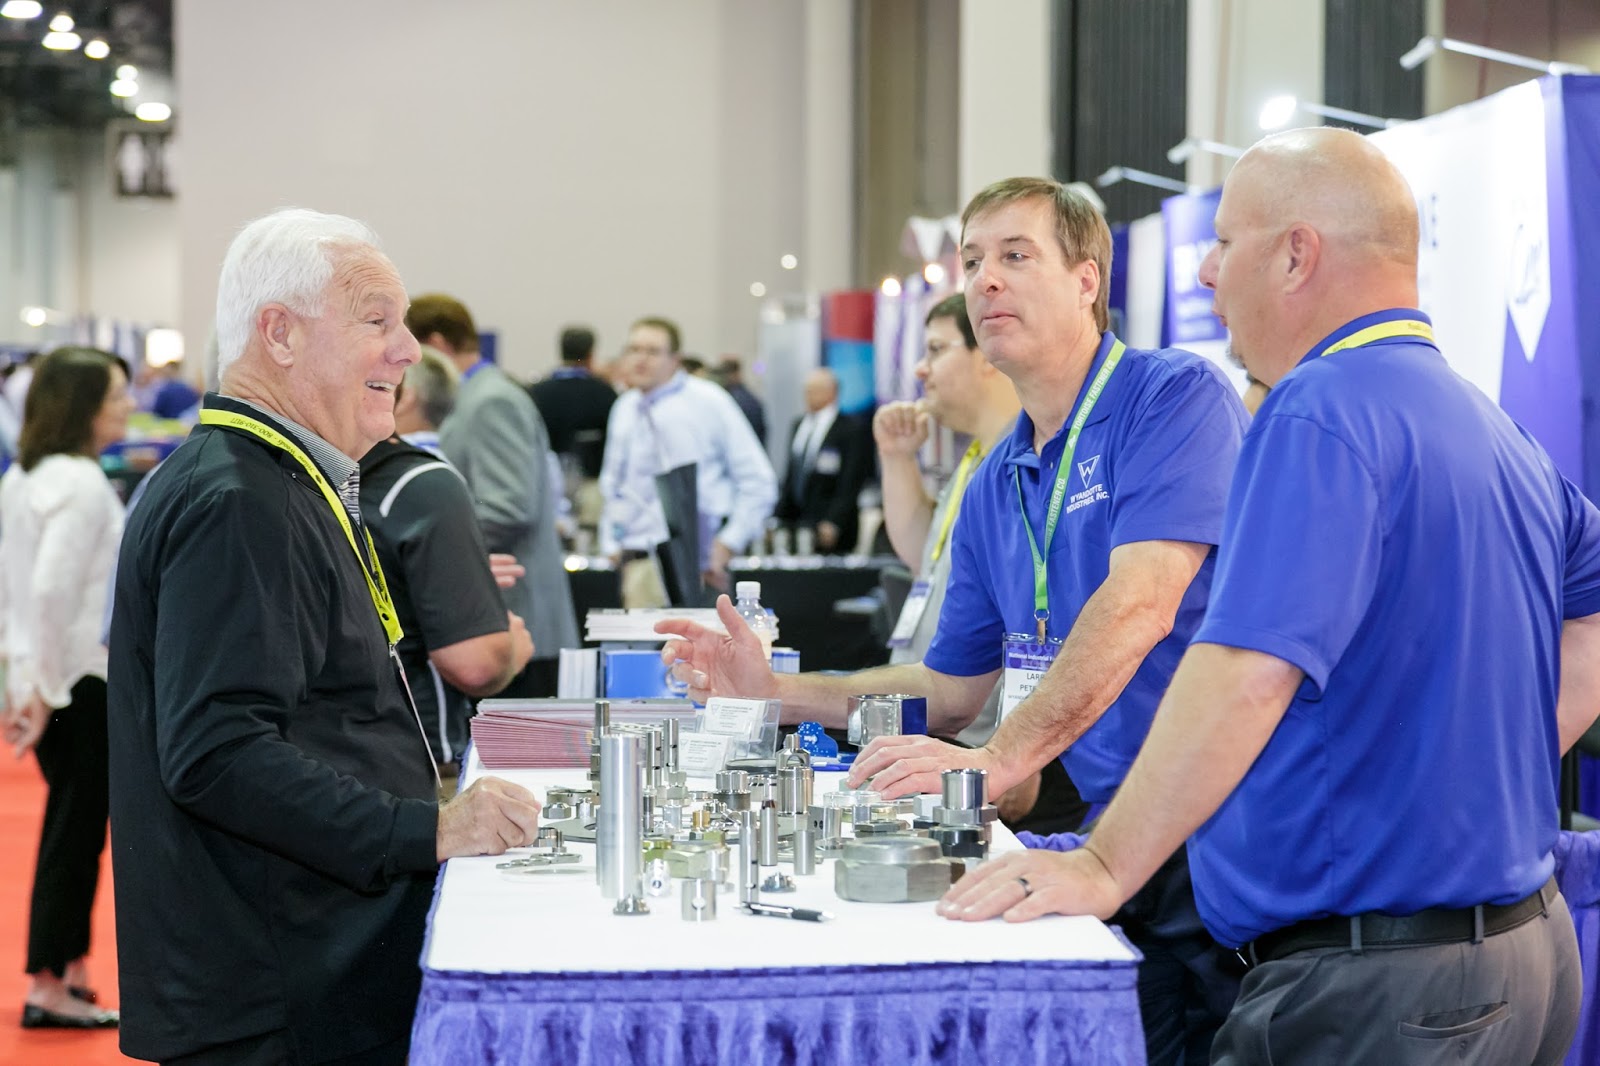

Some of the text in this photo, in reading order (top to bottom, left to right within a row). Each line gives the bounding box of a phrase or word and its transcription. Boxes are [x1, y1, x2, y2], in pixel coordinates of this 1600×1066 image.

[1074, 398, 1094, 429] TORTOISE
[1089, 368, 1111, 399] FASTENER
[277, 439, 296, 455] Woods
[1070, 484, 1103, 503] WYANDOTTE
[1096, 491, 1110, 501] INC.
[1048, 490, 1063, 527] FASTENER
